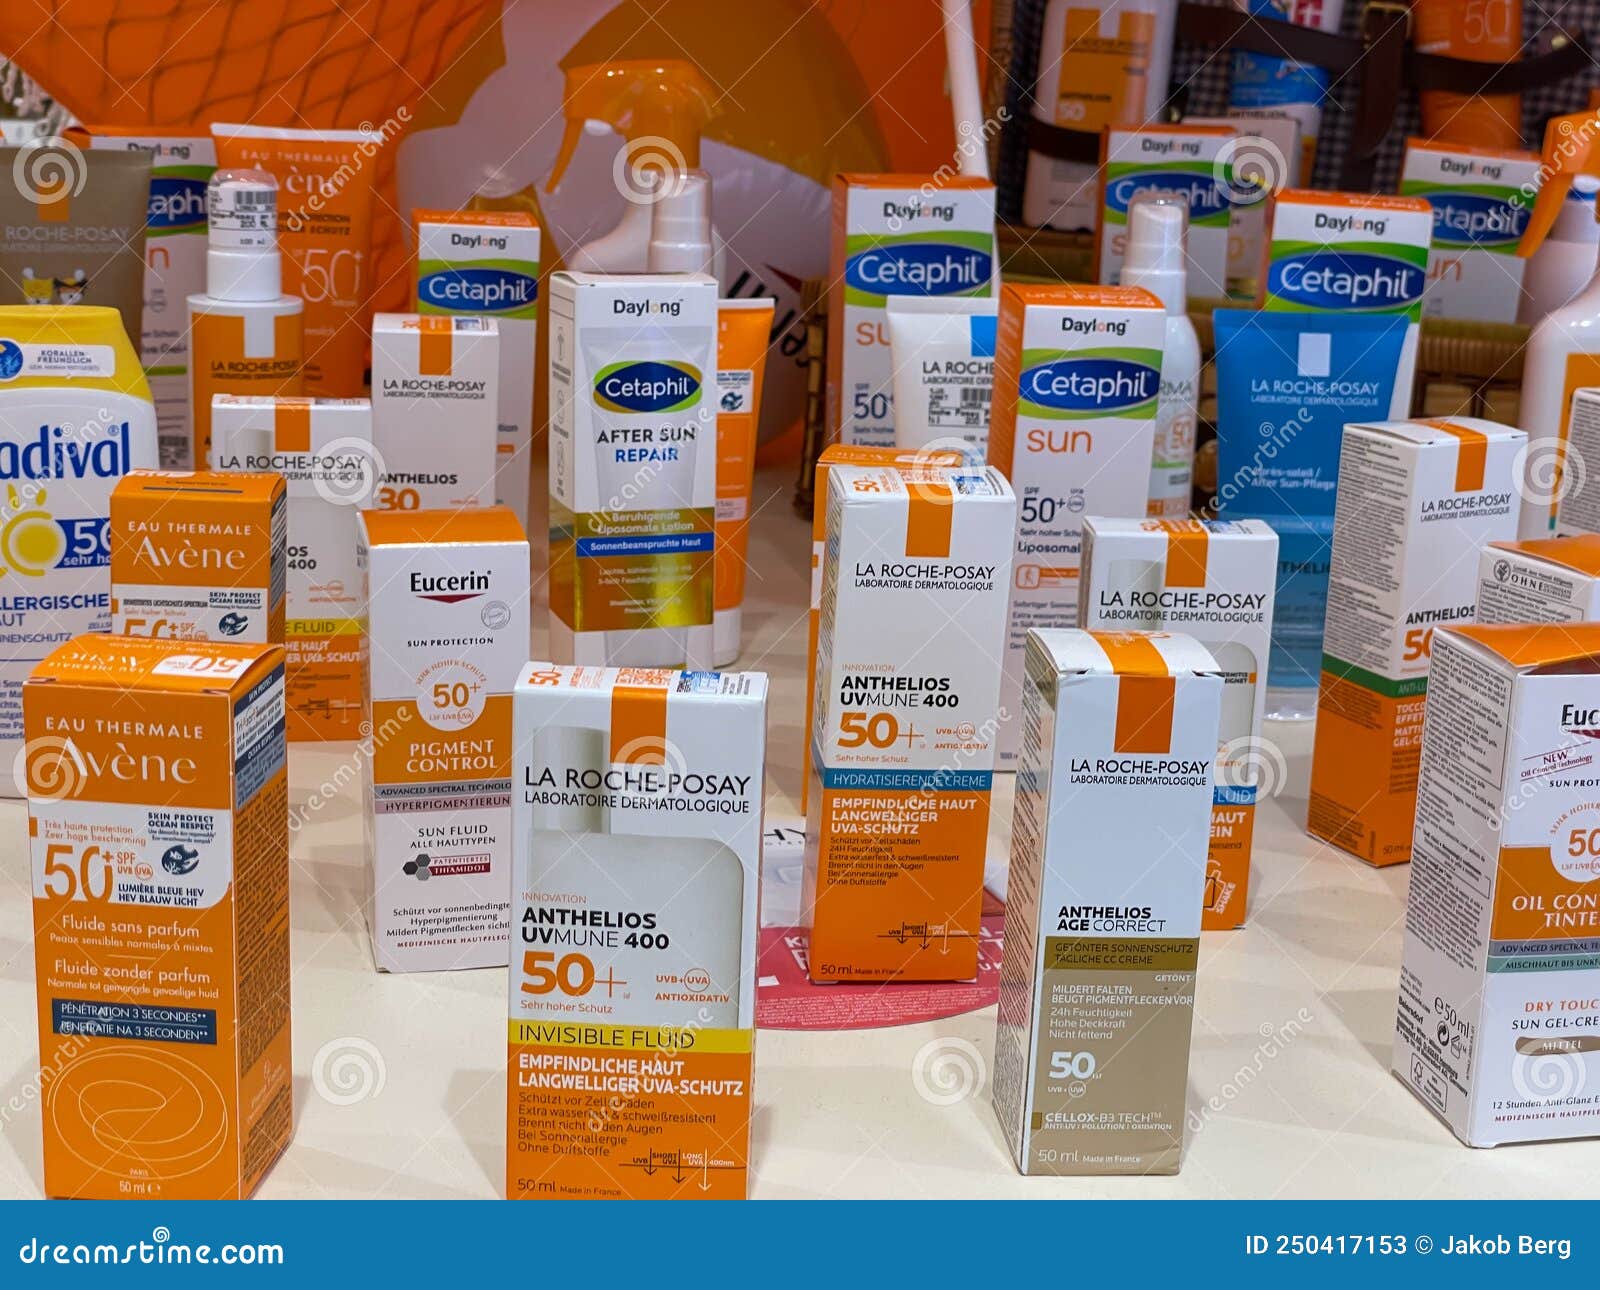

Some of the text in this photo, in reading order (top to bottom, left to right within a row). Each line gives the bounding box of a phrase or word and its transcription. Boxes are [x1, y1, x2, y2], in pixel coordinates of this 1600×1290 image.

[1440, 158, 1503, 179] Daylong
[1314, 213, 1387, 235] Daylong
[451, 233, 509, 249] Daylong
[858, 256, 983, 290] Cetaphil
[1280, 263, 1411, 302] Cetaphil
[429, 276, 529, 306] Cetaphil
[613, 298, 684, 316] Daylong
[1062, 317, 1130, 336] Daylong
[383, 379, 486, 392] LA ROCHE-POSAY
[605, 377, 691, 404] Cetaphil
[1032, 369, 1152, 404] Cetaphil
[1251, 379, 1380, 396] LA ROCHE-POSAY
[597, 427, 696, 444] AFTER SUN
[1026, 428, 1093, 454] sun
[220, 455, 365, 470] LA ROCHE-POSAY
[615, 447, 679, 463] REPAIR
[379, 473, 458, 486] ANTHELIOS
[1422, 493, 1512, 513] LA ROCHE-POSAY
[128, 521, 252, 536] EAU THERMALE
[132, 535, 246, 570] Avène
[591, 538, 702, 552] Sonnenbeanspruchte Haut
[63, 554, 94, 567] sehr
[288, 559, 317, 570] 400
[856, 562, 996, 581] LA ROCHE-POSAY
[410, 571, 490, 593] Eucerin
[855, 578, 994, 591] LABORATOIRE DERMATOLOGIQUE
[1100, 590, 1267, 609] LA ROCHE-POSAY
[1099, 609, 1264, 624] LABORATOIRE DERMATOLOGIQUE
[294, 622, 336, 633] FLUID
[407, 637, 494, 648] SUN PROTECTION
[842, 663, 896, 673] INNOVATION
[841, 676, 951, 691] ANTHELIOS
[840, 692, 959, 708] UVMUNE 400
[46, 717, 203, 740] EAU THERMALE
[837, 711, 925, 749] 50+
[410, 739, 494, 758] PIGMENT
[53, 736, 197, 784] Avène
[406, 755, 498, 773] CONTROL
[1543, 750, 1568, 765] NEW
[1071, 759, 1209, 775] LA ROCHE-POSAY
[525, 766, 751, 797] LA ROCHE-POSAY
[834, 774, 987, 788] HYDRATISIERENDE CREME
[1070, 775, 1207, 787] LABORATOIRE DERMATOLOGIQUE
[525, 791, 749, 815] LABORATOIRE DERMATOLOGIQUE
[832, 798, 977, 811] EMPFINDLICHE HAUT
[148, 812, 214, 823] SKIN PROTECT
[832, 810, 938, 823] LANGWELLIGER
[148, 820, 214, 831] OCEAN RESPECT
[418, 825, 488, 838] SUN FLUID
[410, 836, 496, 849] ALLE HAUTTYPEN
[117, 851, 136, 864] SPF
[433, 855, 488, 866] PATENTIERTES
[117, 865, 132, 875] UVB
[434, 864, 486, 875] THIAMIDOL
[118, 882, 204, 898] LUMIÈRE BLEUE HEV
[118, 892, 198, 907] HEV BLAUW LICHT
[522, 892, 587, 904] INNOVATION
[410, 912, 498, 927] Hyperpigmentierung
[522, 906, 657, 929] ANTHELIOS
[1058, 906, 1152, 919] ANTHELIOS
[62, 915, 200, 938] Fluide sans parfum
[1057, 919, 1166, 932] AGE CORRECT
[522, 926, 670, 950] UVMUNE 400
[1500, 943, 1547, 954] ADVANCED
[1562, 958, 1575, 968] BIS
[55, 960, 210, 985] Fluide zonder parfum
[520, 950, 627, 999] 50+
[1053, 984, 1133, 995] MILDERT FALTEN
[655, 993, 730, 1004] ANTIOXIDATIV
[1052, 994, 1193, 1005] BEUGT PIGMENTFLECKEN VOR
[520, 999, 613, 1014] Sehr hoher Schutz
[1050, 1007, 1132, 1020] 24h Feuchtigkeit
[1050, 1018, 1126, 1029] Hohe Deckkraft
[520, 1024, 695, 1049] INVISIBLE FLUID
[1050, 1029, 1113, 1040] Nicht fettend
[519, 1053, 684, 1077] EMPFINDLICHE HAUT
[519, 1072, 744, 1097] LANGWELLIGER UVA-SCHUTZ
[1493, 1095, 1591, 1110] 12 Stunden Anti-Glanz
[518, 1129, 627, 1146] Bei Sonnenallergie
[682, 1153, 703, 1161] LONG
